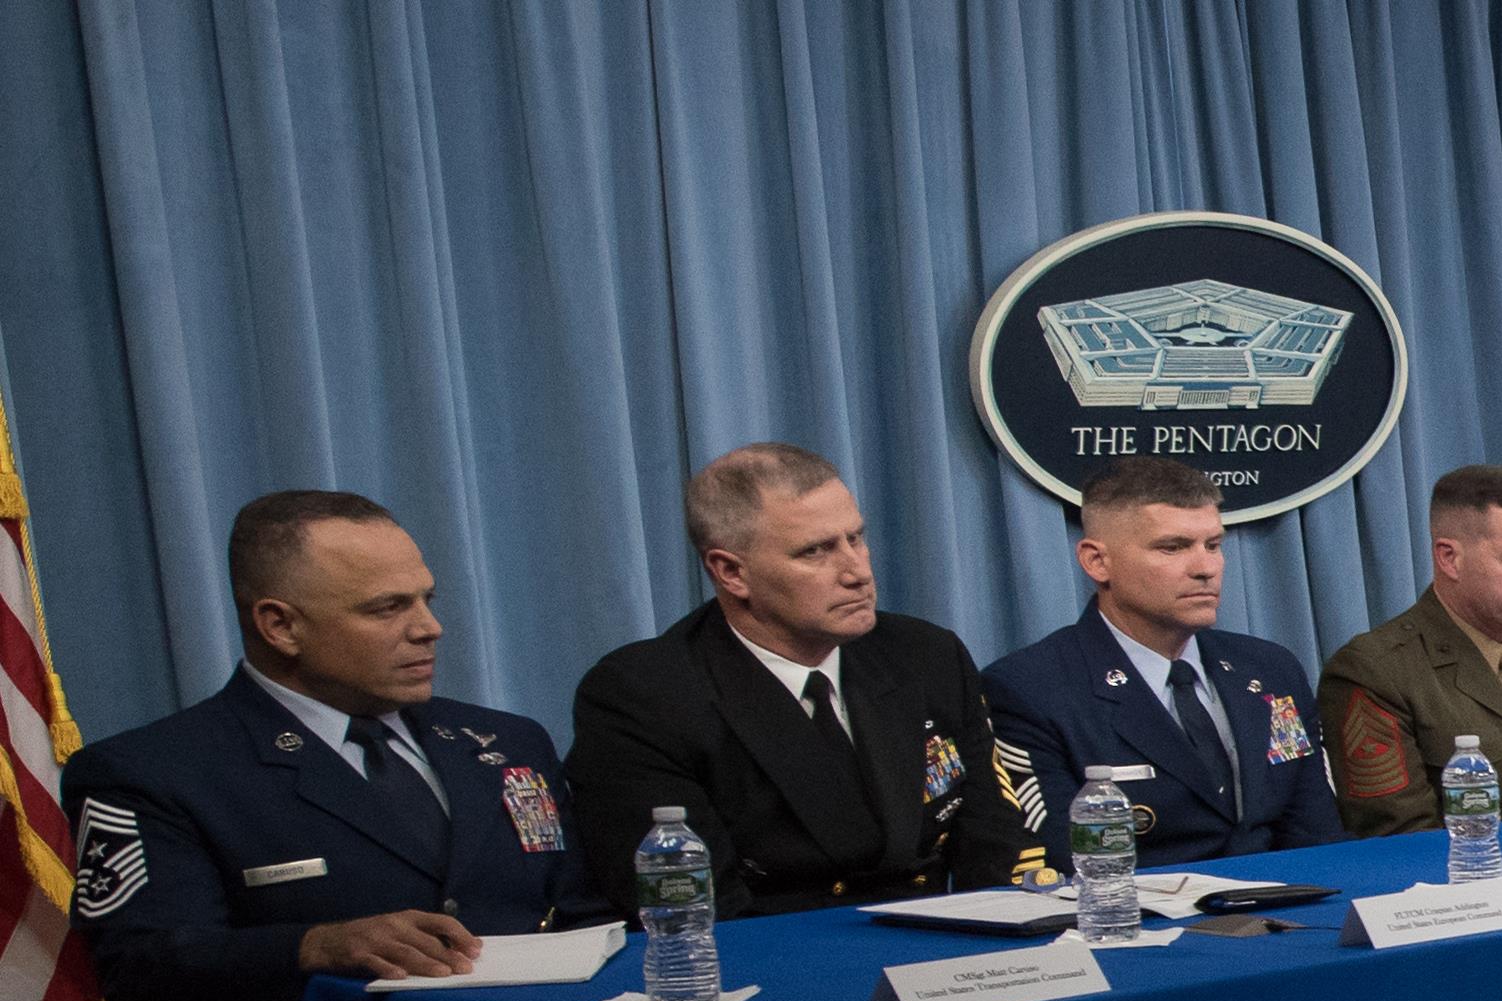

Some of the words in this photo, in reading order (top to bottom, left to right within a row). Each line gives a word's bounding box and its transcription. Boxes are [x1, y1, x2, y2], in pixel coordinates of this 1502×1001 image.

[1071, 427, 1138, 456] THE
[1152, 423, 1323, 455] PENTAGON
[267, 866, 304, 879] CARUSO
[659, 886, 696, 898] Spring
[1387, 922, 1411, 931] United
[1432, 914, 1466, 925] European
[1466, 909, 1502, 920] Command
[953, 971, 985, 983] CMSgt
[985, 968, 1006, 977] Matt
[1007, 964, 1039, 975] Caruso
[915, 988, 947, 1000] United
[948, 986, 974, 994] States
[976, 976, 1041, 991] Transportation
[1040, 968, 1087, 982] Command
